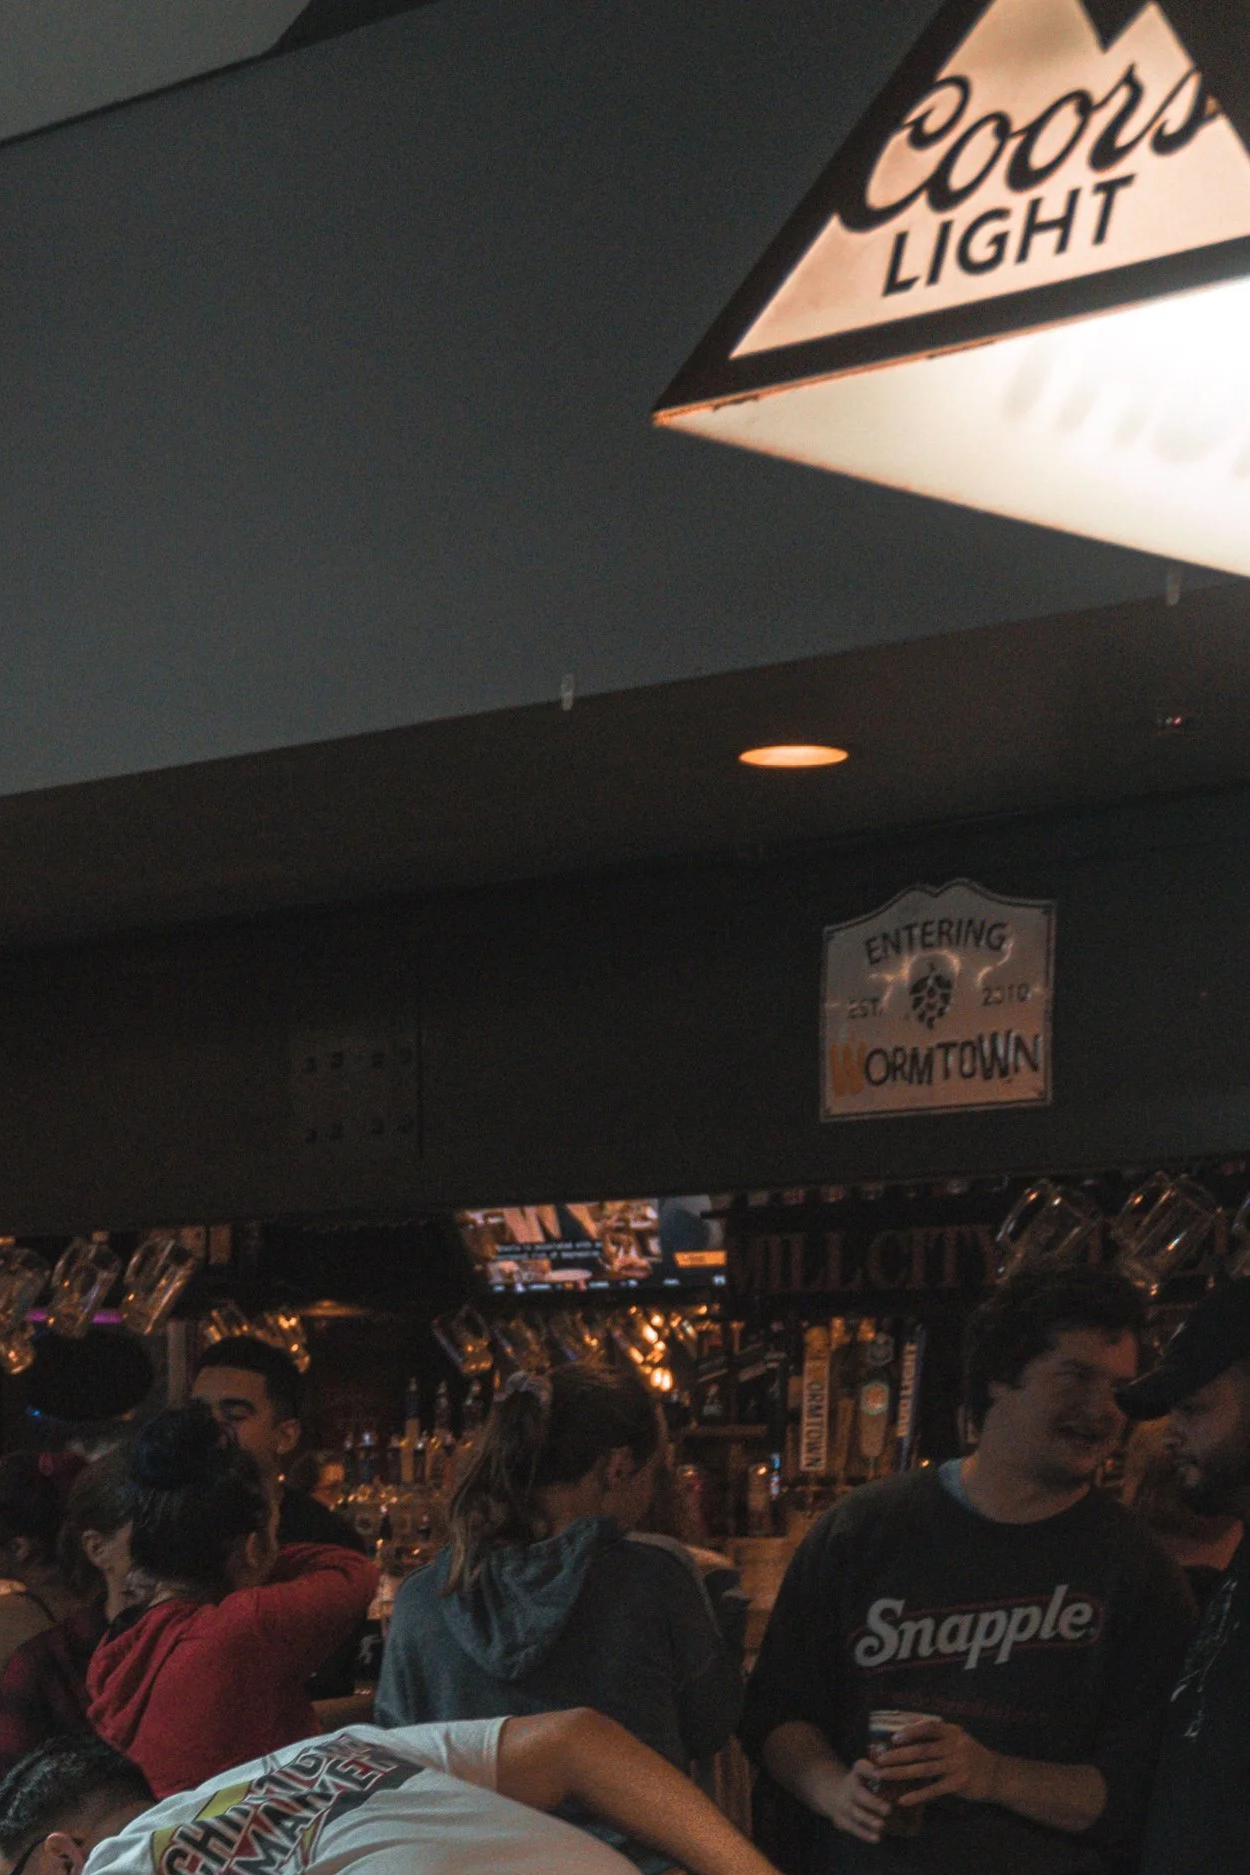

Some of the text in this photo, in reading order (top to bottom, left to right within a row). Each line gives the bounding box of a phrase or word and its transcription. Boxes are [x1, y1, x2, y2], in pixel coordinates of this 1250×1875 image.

[838, 64, 1220, 233] Coors
[882, 173, 1136, 298] LIGHT
[865, 918, 1010, 966] ENTERING
[830, 1029, 1041, 1098] WORMTOWN
[853, 1584, 1096, 1671] Snapple
